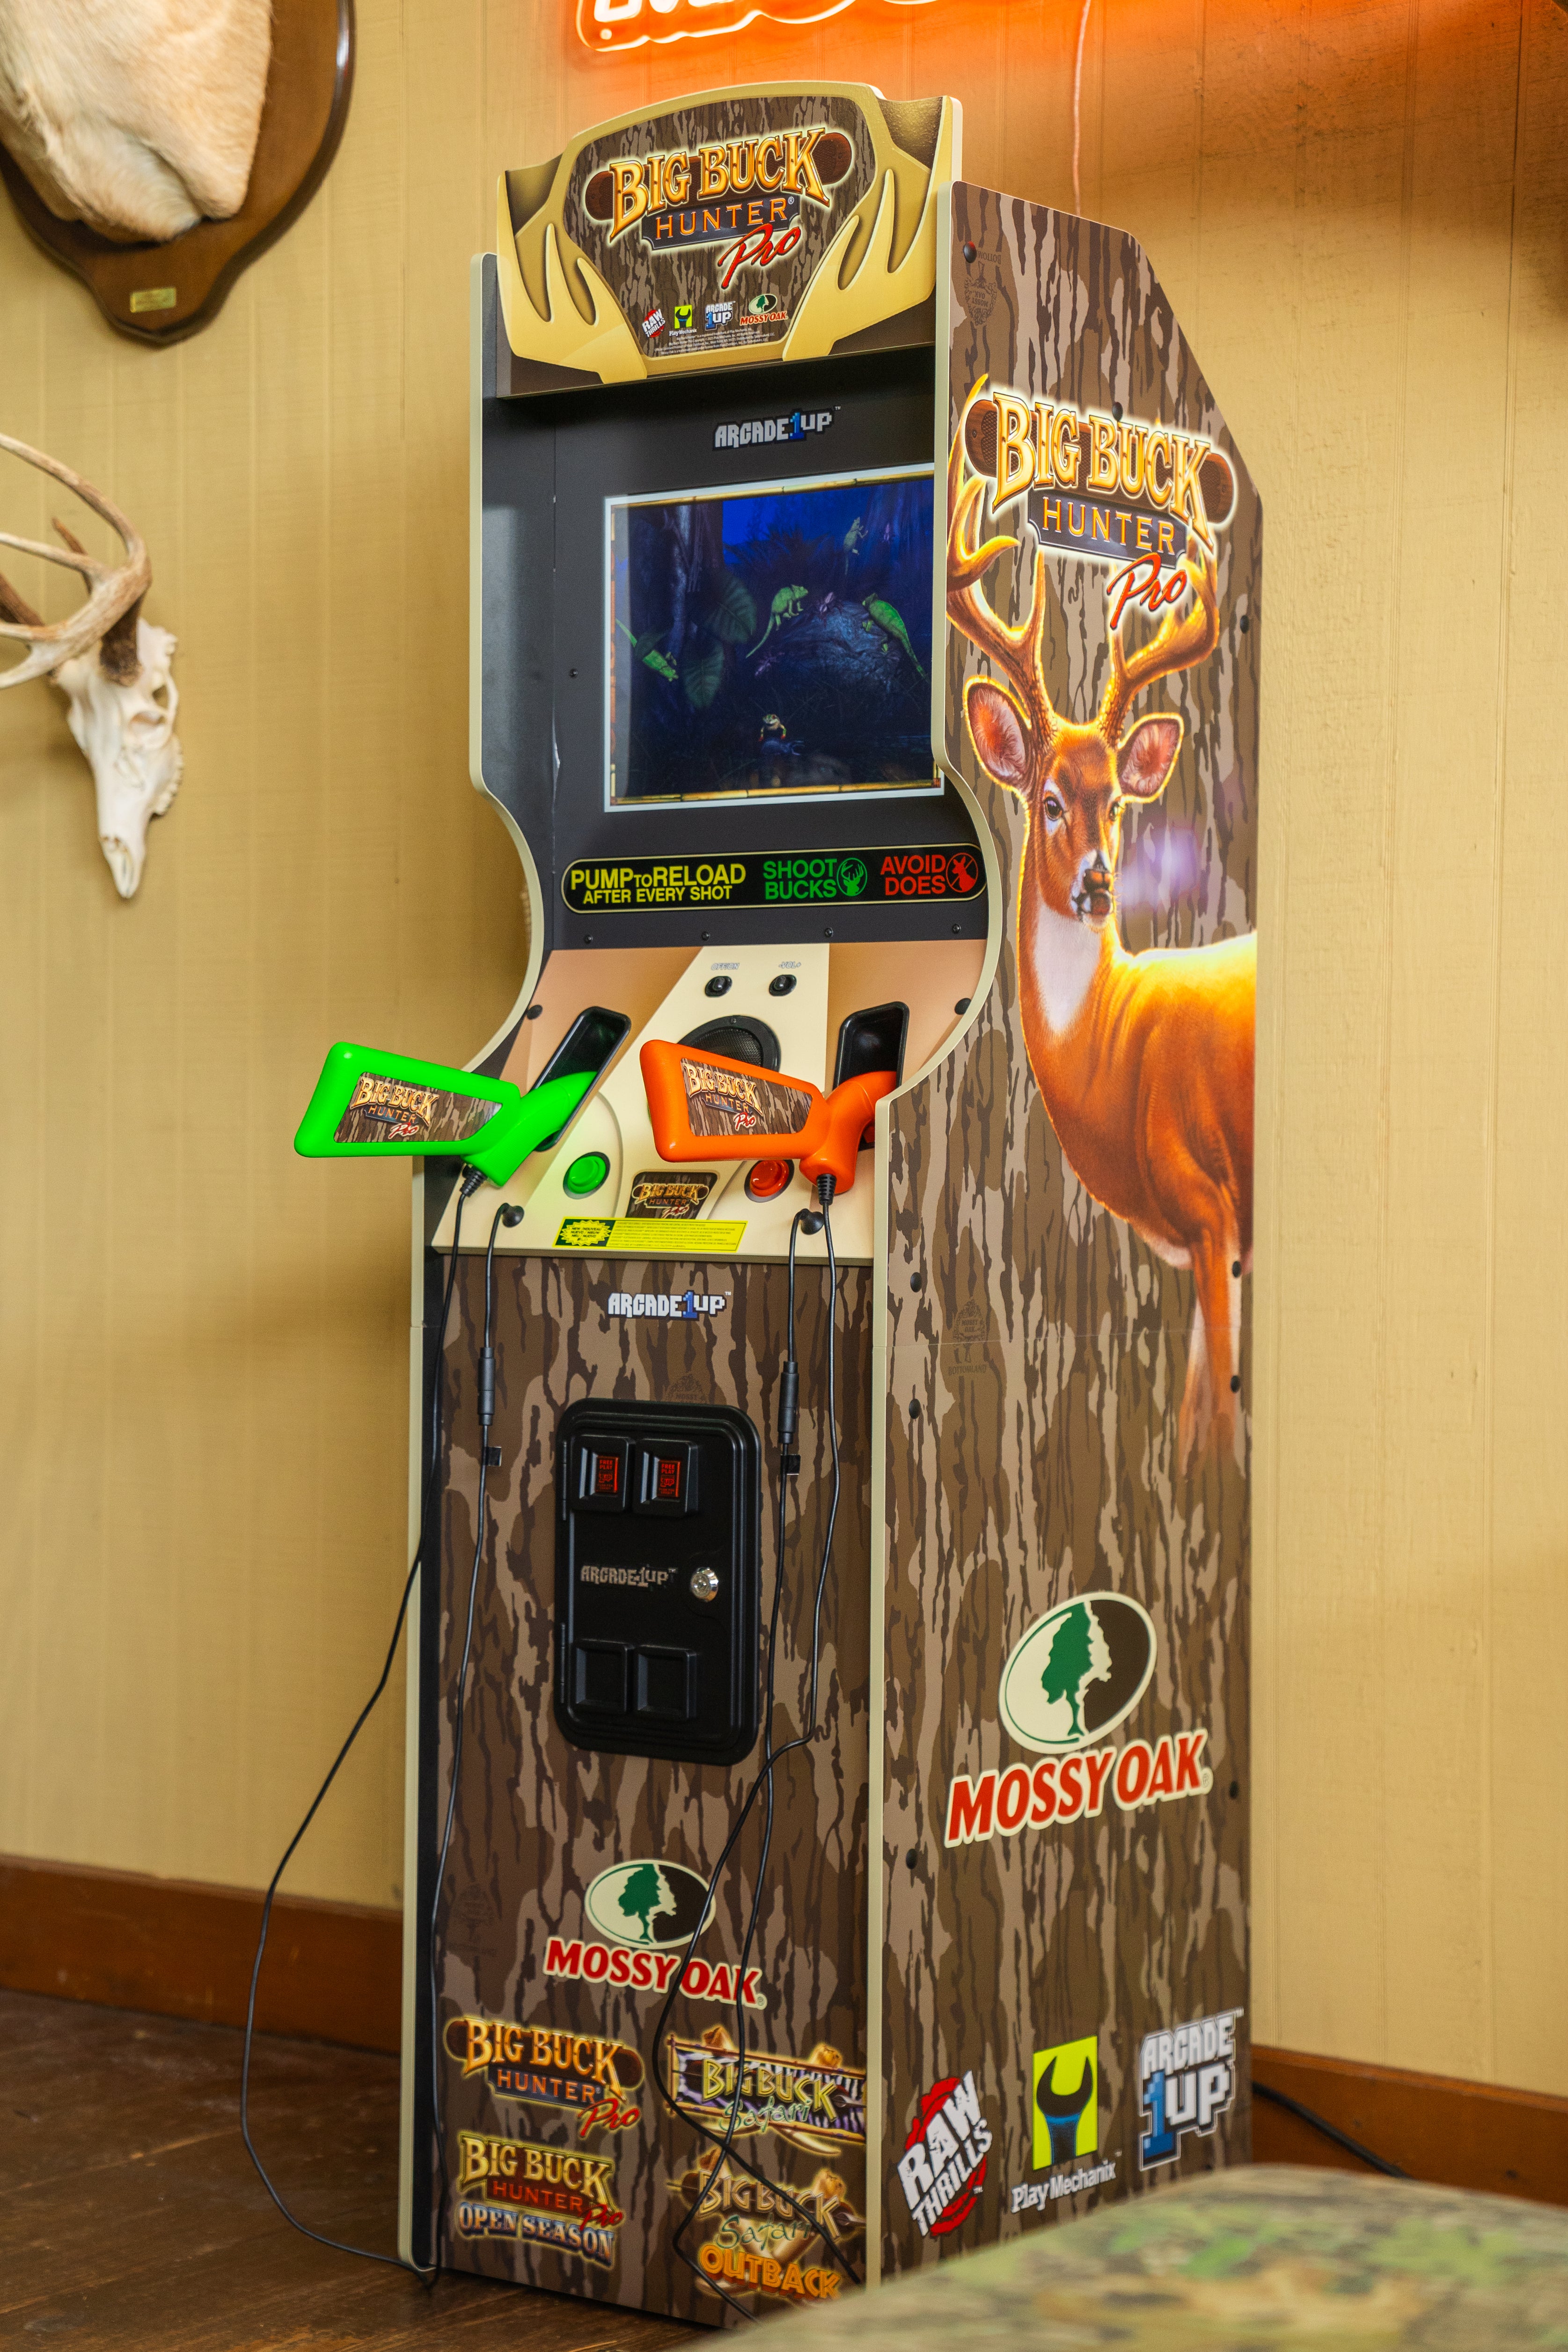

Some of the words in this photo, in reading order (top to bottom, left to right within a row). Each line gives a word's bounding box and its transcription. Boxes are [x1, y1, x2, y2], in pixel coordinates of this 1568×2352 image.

[610, 151, 691, 243] BIG
[698, 127, 829, 207] BUCK
[718, 223, 801, 289] Pro
[642, 308, 663, 332] RAW
[645, 317, 666, 337] THRILLS
[706, 311, 732, 328] 1UP
[740, 314, 769, 326] MOSSY
[992, 392, 1081, 514] BIG
[1088, 414, 1214, 554] BUCK
[1042, 496, 1176, 555] HUNTER
[1106, 552, 1187, 630] Pro
[571, 867, 634, 890] PUMP
[634, 874, 653, 887] TO
[653, 863, 746, 887] RELOAD
[762, 858, 837, 880] SHOOT
[880, 854, 946, 875] AVOID
[885, 874, 946, 896] DOES
[582, 889, 631, 904] AFTER
[636, 887, 686, 902] EVERY
[689, 885, 733, 901] SHOT
[764, 878, 837, 900] BUCKS
[350, 1077, 391, 1110] BIG
[389, 1084, 439, 1127] BUCK
[683, 1063, 715, 1098] BIG
[714, 1071, 763, 1117] BUCK
[705, 1093, 749, 1113] HUNTER
[368, 1105, 417, 1124] HUNTER
[388, 1122, 418, 1139] Pro
[733, 1112, 756, 1131] Pro
[637, 1184, 665, 1202] BIG
[664, 1184, 700, 1203] BUCK
[946, 1748, 1116, 1846] MOSSY
[544, 1938, 680, 1992] MOSSY
[463, 2018, 524, 2075] BIG
[529, 2028, 626, 2103] BUCK
[718, 2096, 811, 2132] Safari
[757, 2066, 838, 2122] BUCK
[1142, 2063, 1233, 2159] 1UP
[578, 2097, 640, 2138] Pro
[897, 2069, 982, 2210] RAW
[462, 2137, 518, 2185] BIG
[523, 2148, 612, 2212] BUCK
[699, 2169, 751, 2215] BIG
[912, 2118, 993, 2236] THRILLS
[1011, 2182, 1050, 2213] Play
[1049, 2158, 1116, 2199] Mechanix
[492, 2181, 583, 2213] HUNTER
[579, 2204, 623, 2230] Pro
[459, 2201, 519, 2232] OPEN
[522, 2213, 614, 2265] SEASON
[700, 2244, 841, 2300] OUTBACK
